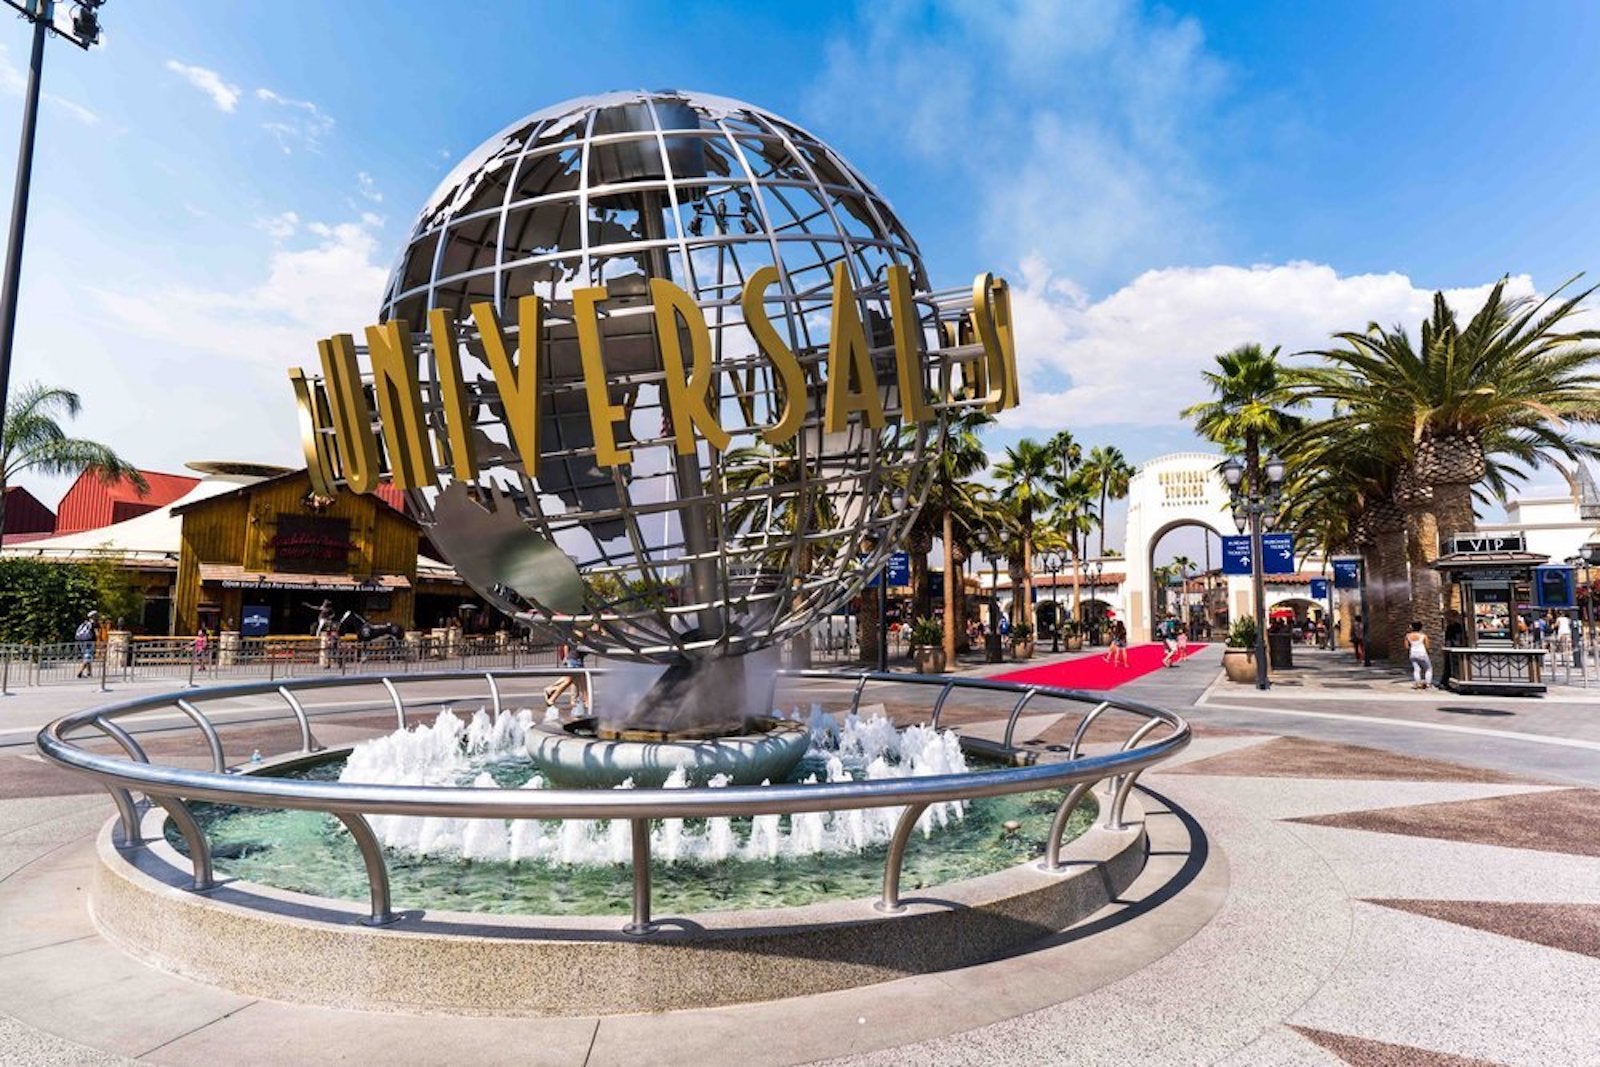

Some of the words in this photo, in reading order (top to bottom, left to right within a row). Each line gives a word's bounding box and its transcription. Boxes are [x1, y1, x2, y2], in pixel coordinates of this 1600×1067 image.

[317, 261, 936, 495] UNIVERSAL
[1159, 471, 1210, 485] UNIVERSAL
[1165, 484, 1204, 499] STUDIOS
[1470, 538, 1504, 551] VIP
